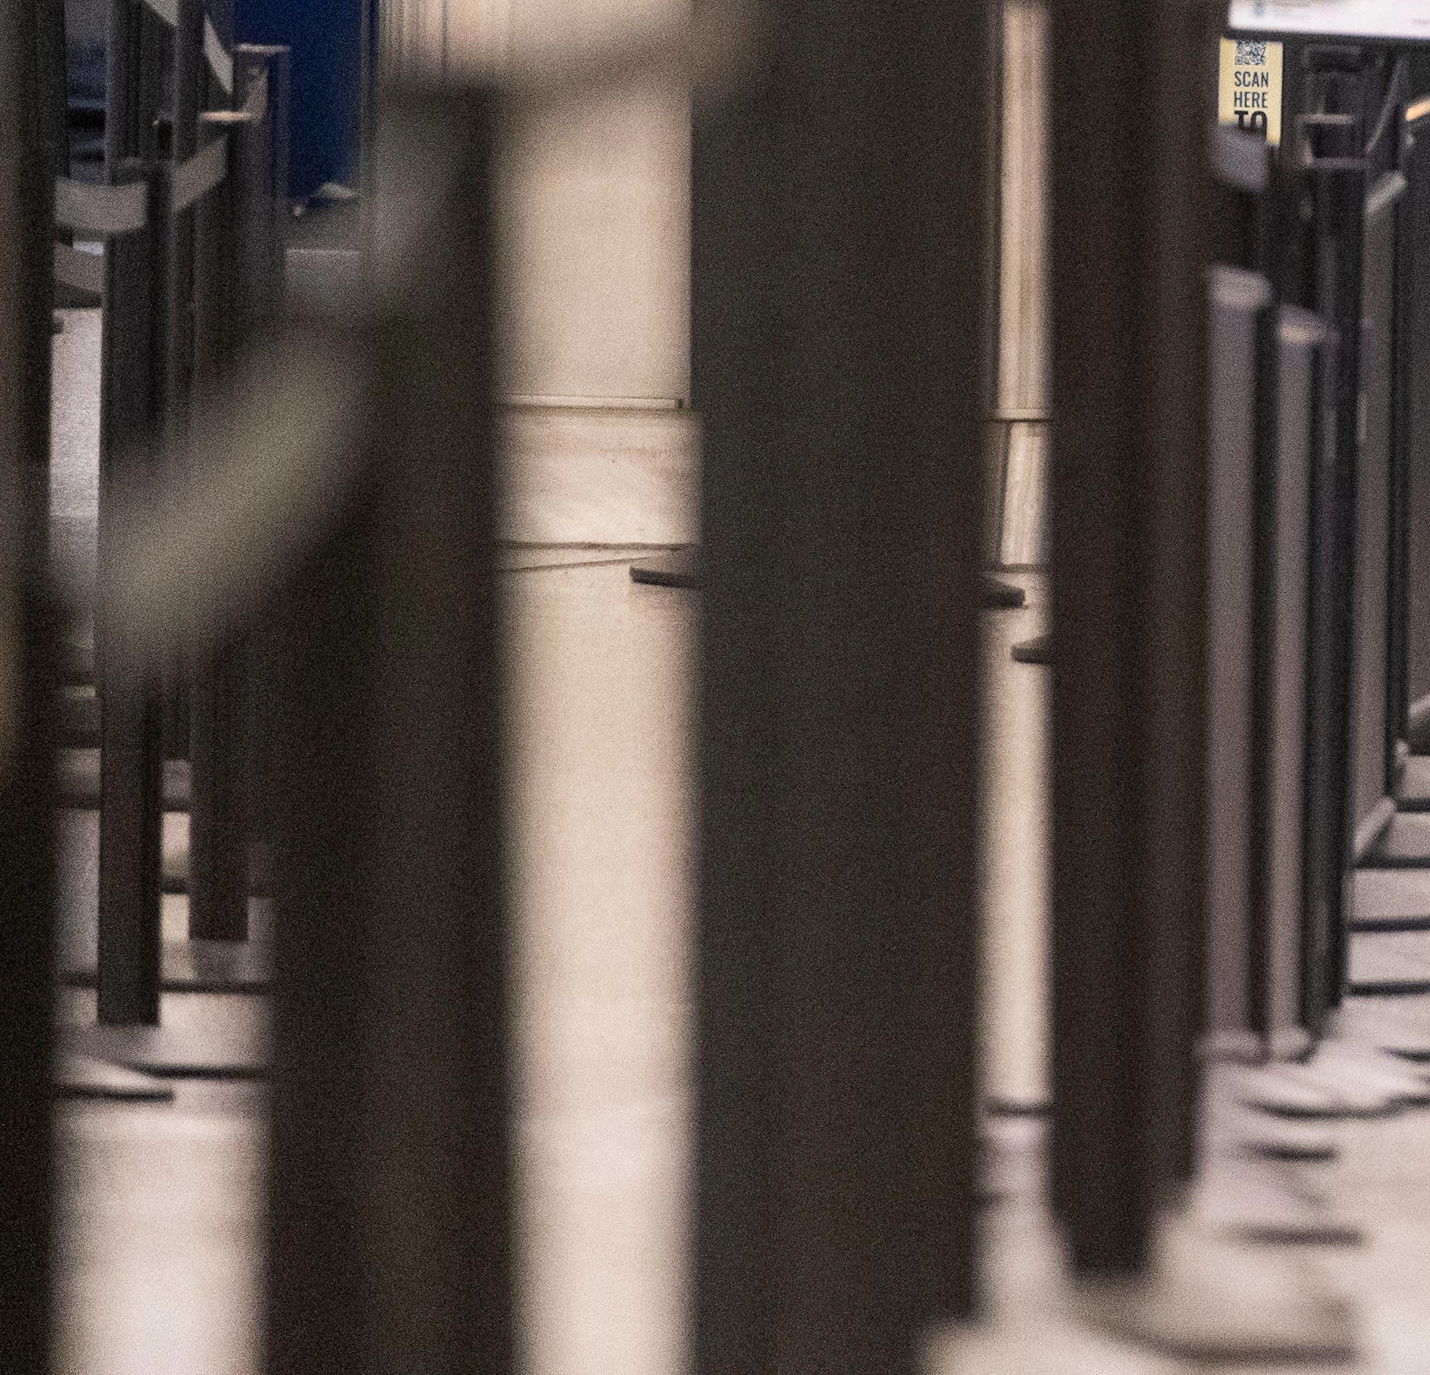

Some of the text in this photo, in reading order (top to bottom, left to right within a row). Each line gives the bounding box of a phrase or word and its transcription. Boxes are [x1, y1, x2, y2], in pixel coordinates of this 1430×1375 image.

[1233, 71, 1270, 87] SCAN
[1233, 91, 1268, 108] HERE
[1233, 110, 1268, 132] TO
